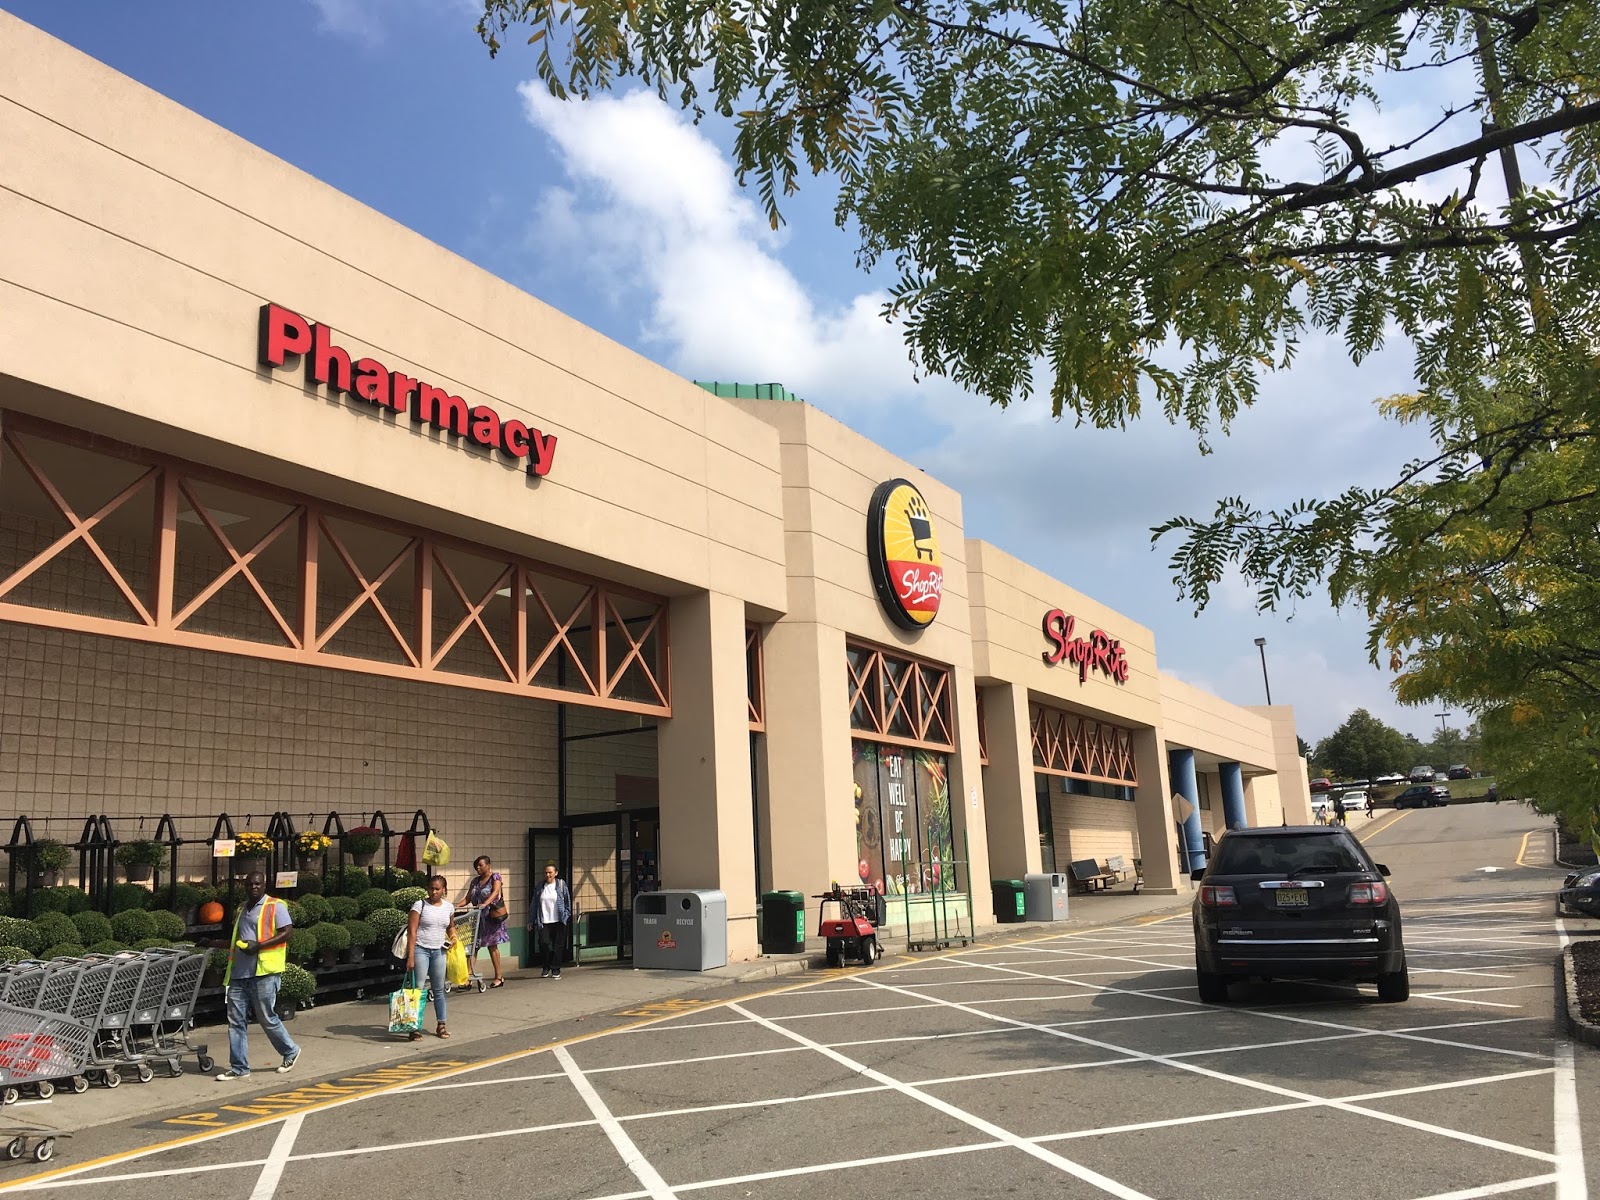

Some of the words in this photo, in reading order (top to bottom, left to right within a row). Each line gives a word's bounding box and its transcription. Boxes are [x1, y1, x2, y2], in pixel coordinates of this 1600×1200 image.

[259, 302, 557, 476] Pharmacy
[1042, 608, 1129, 682] ShopRite
[889, 755, 902, 778] EAT
[888, 782, 907, 806] WELL
[895, 810, 903, 834] BE
[676, 918, 694, 926] RECYCLE
